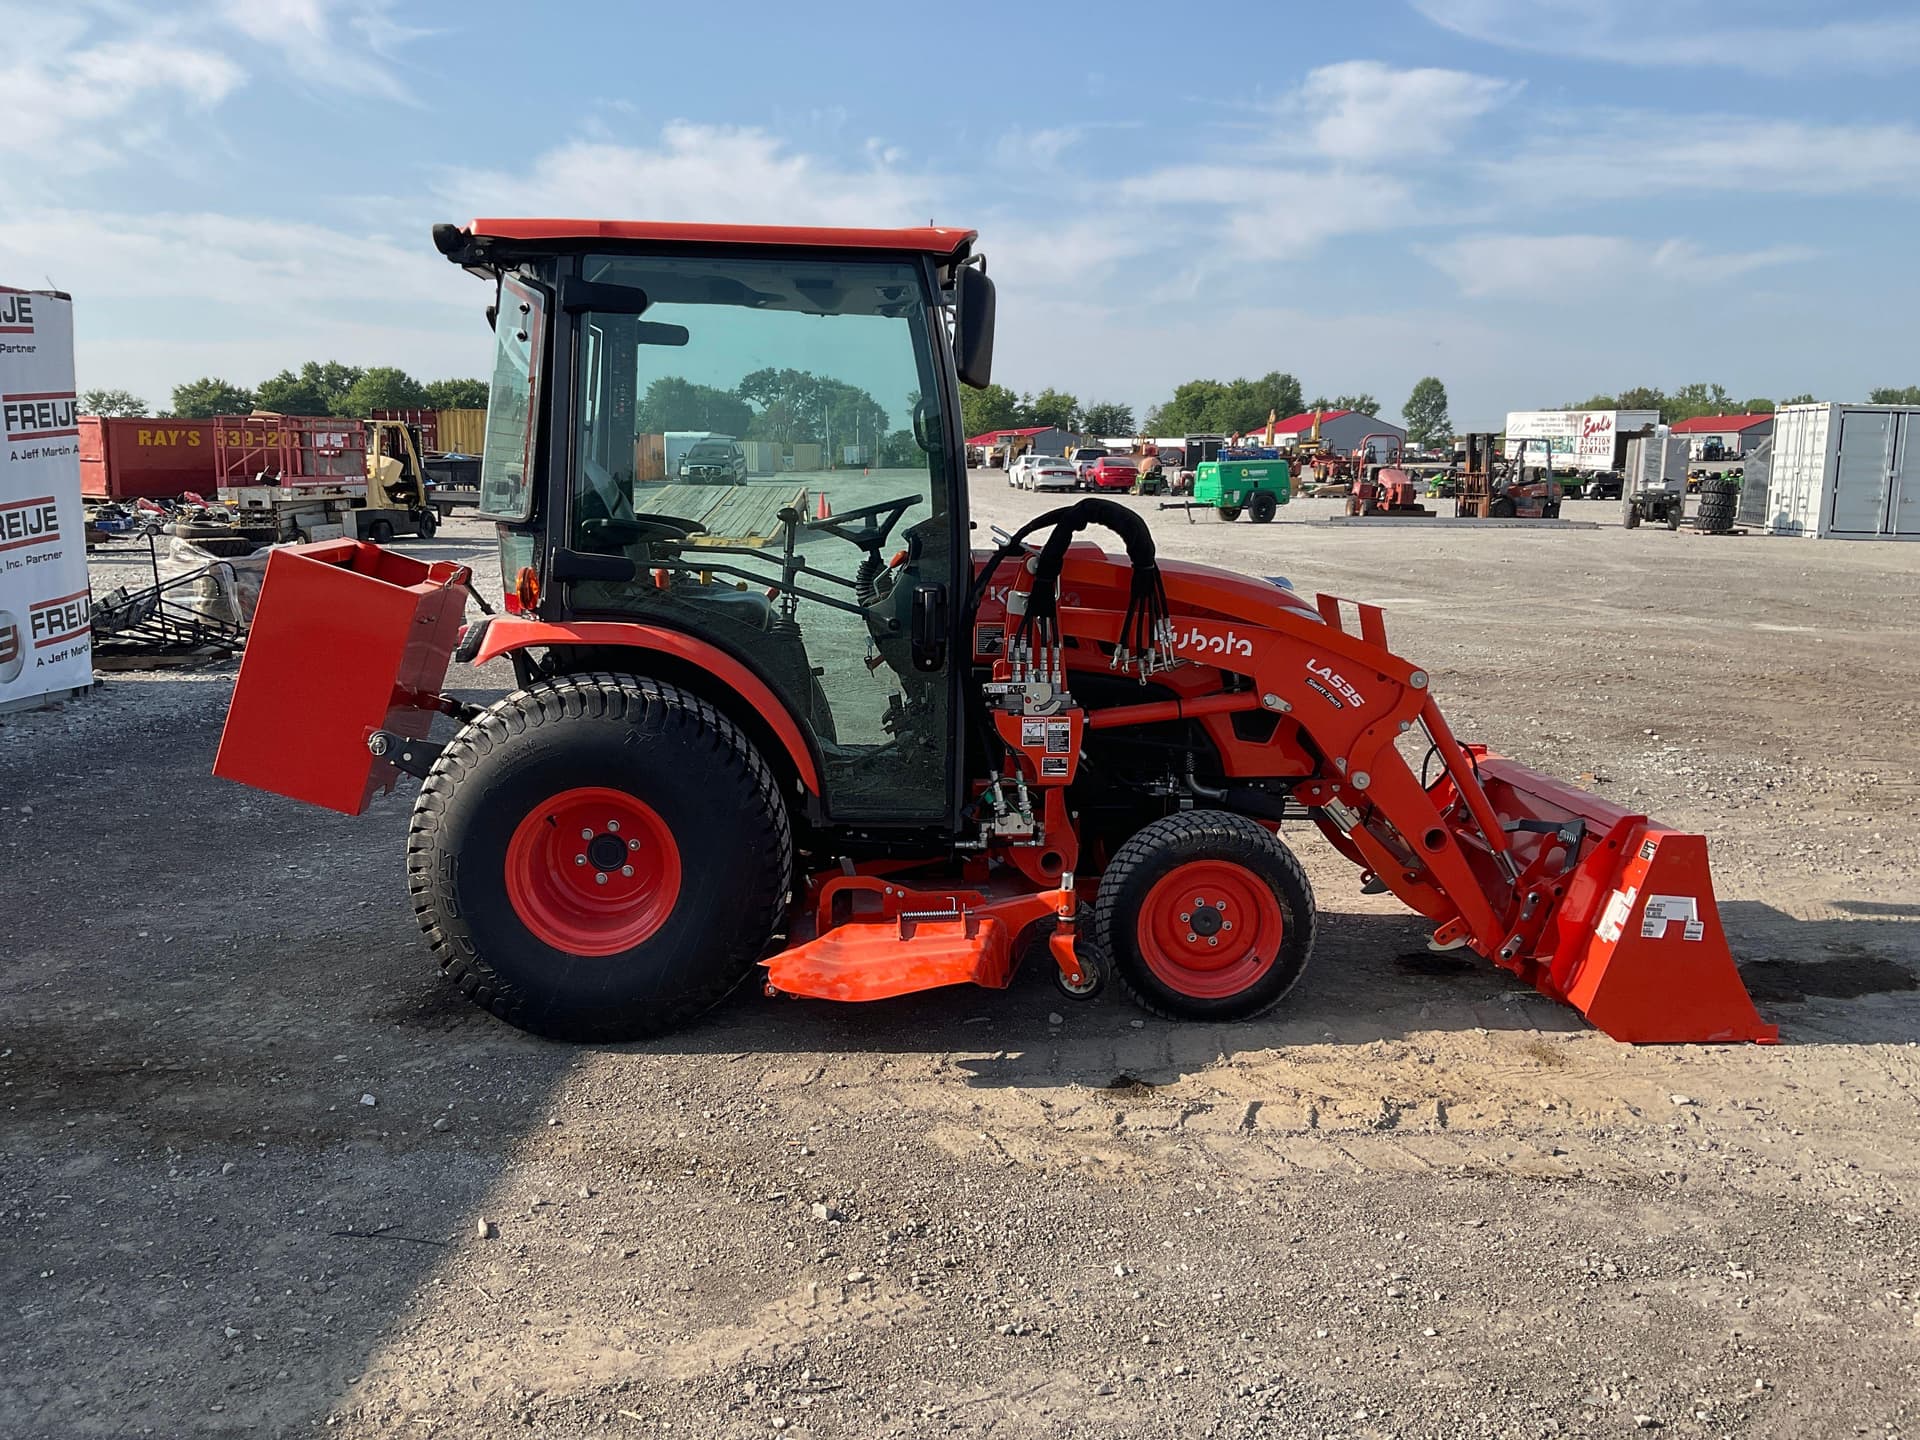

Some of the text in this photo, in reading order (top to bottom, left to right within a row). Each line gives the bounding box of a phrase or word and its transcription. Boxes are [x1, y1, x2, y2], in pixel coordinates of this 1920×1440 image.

[138, 429, 200, 447] RAY'S
[1581, 437, 1611, 445] AUCTION
[10, 450, 18, 461] A
[21, 448, 39, 460] Jeff
[42, 445, 70, 457] Martin
[1579, 445, 1611, 455] COMPANY
[6, 552, 62, 570] Inc. Partner
[36, 657, 45, 668] A
[48, 650, 68, 663] Jeff
[1306, 658, 1366, 708] LA535
